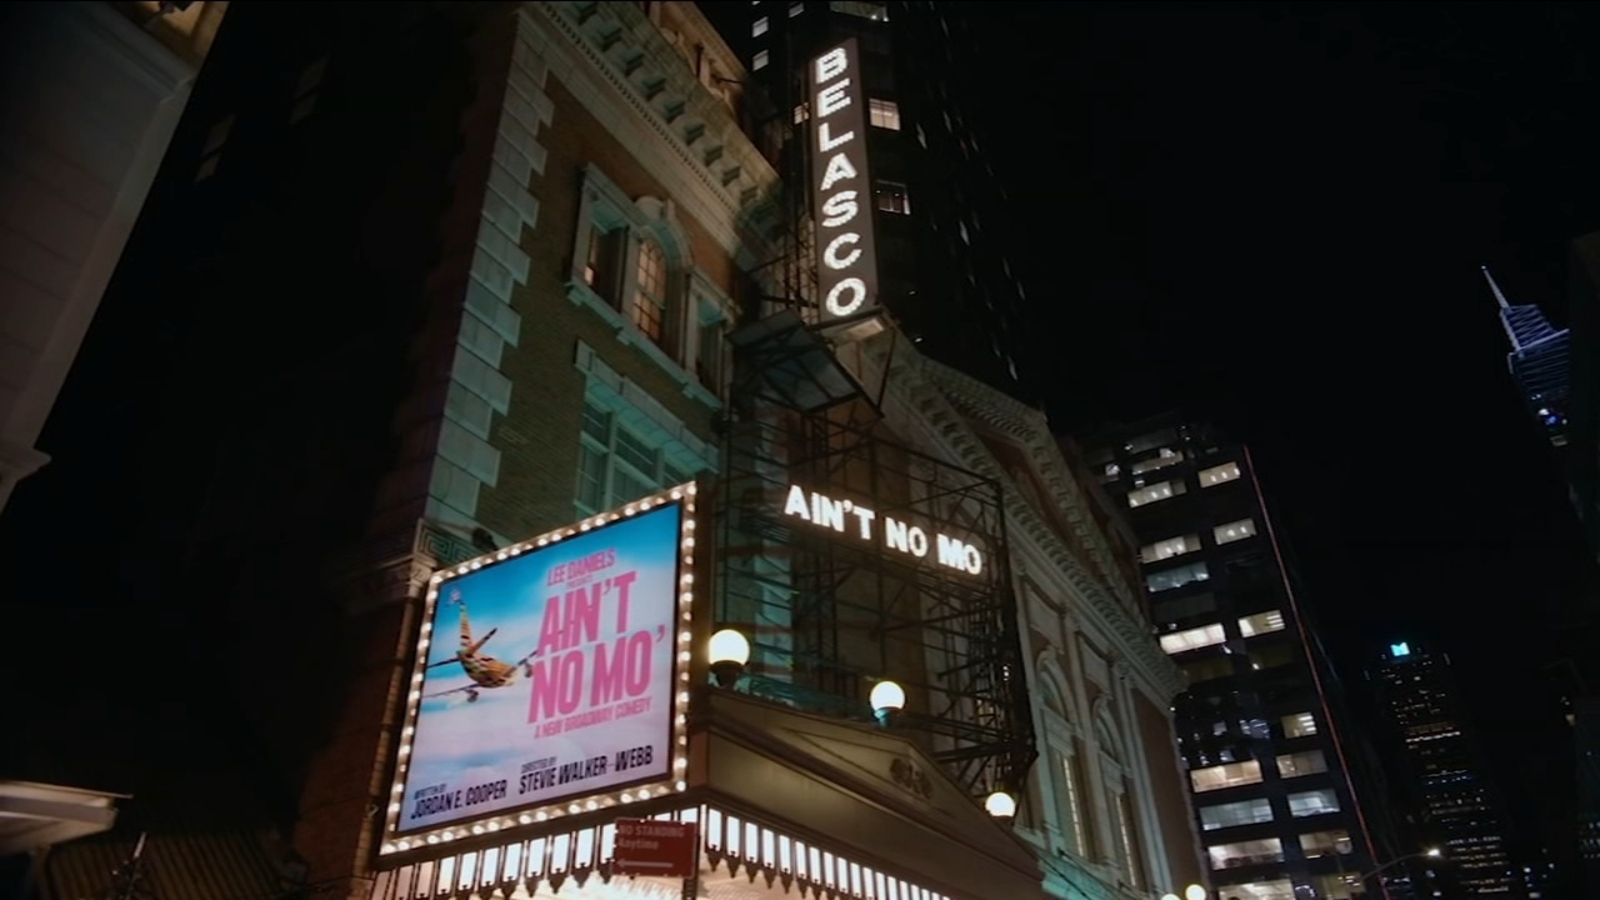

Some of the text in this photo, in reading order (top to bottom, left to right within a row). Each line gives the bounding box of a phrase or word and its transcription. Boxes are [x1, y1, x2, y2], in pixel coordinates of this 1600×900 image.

[815, 47, 866, 316] BELASCO
[784, 484, 982, 575] AIN'T NO MO
[547, 564, 567, 586] LEE
[567, 547, 616, 579] DANIELS
[536, 570, 637, 658] AIN'T
[527, 624, 666, 724] NO MO'
[615, 696, 653, 720] COMEDY
[410, 792, 454, 820] JORDAN
[465, 779, 508, 806] COOPER
[519, 767, 557, 795] STEVIE
[619, 824, 685, 838] NO STANDING
